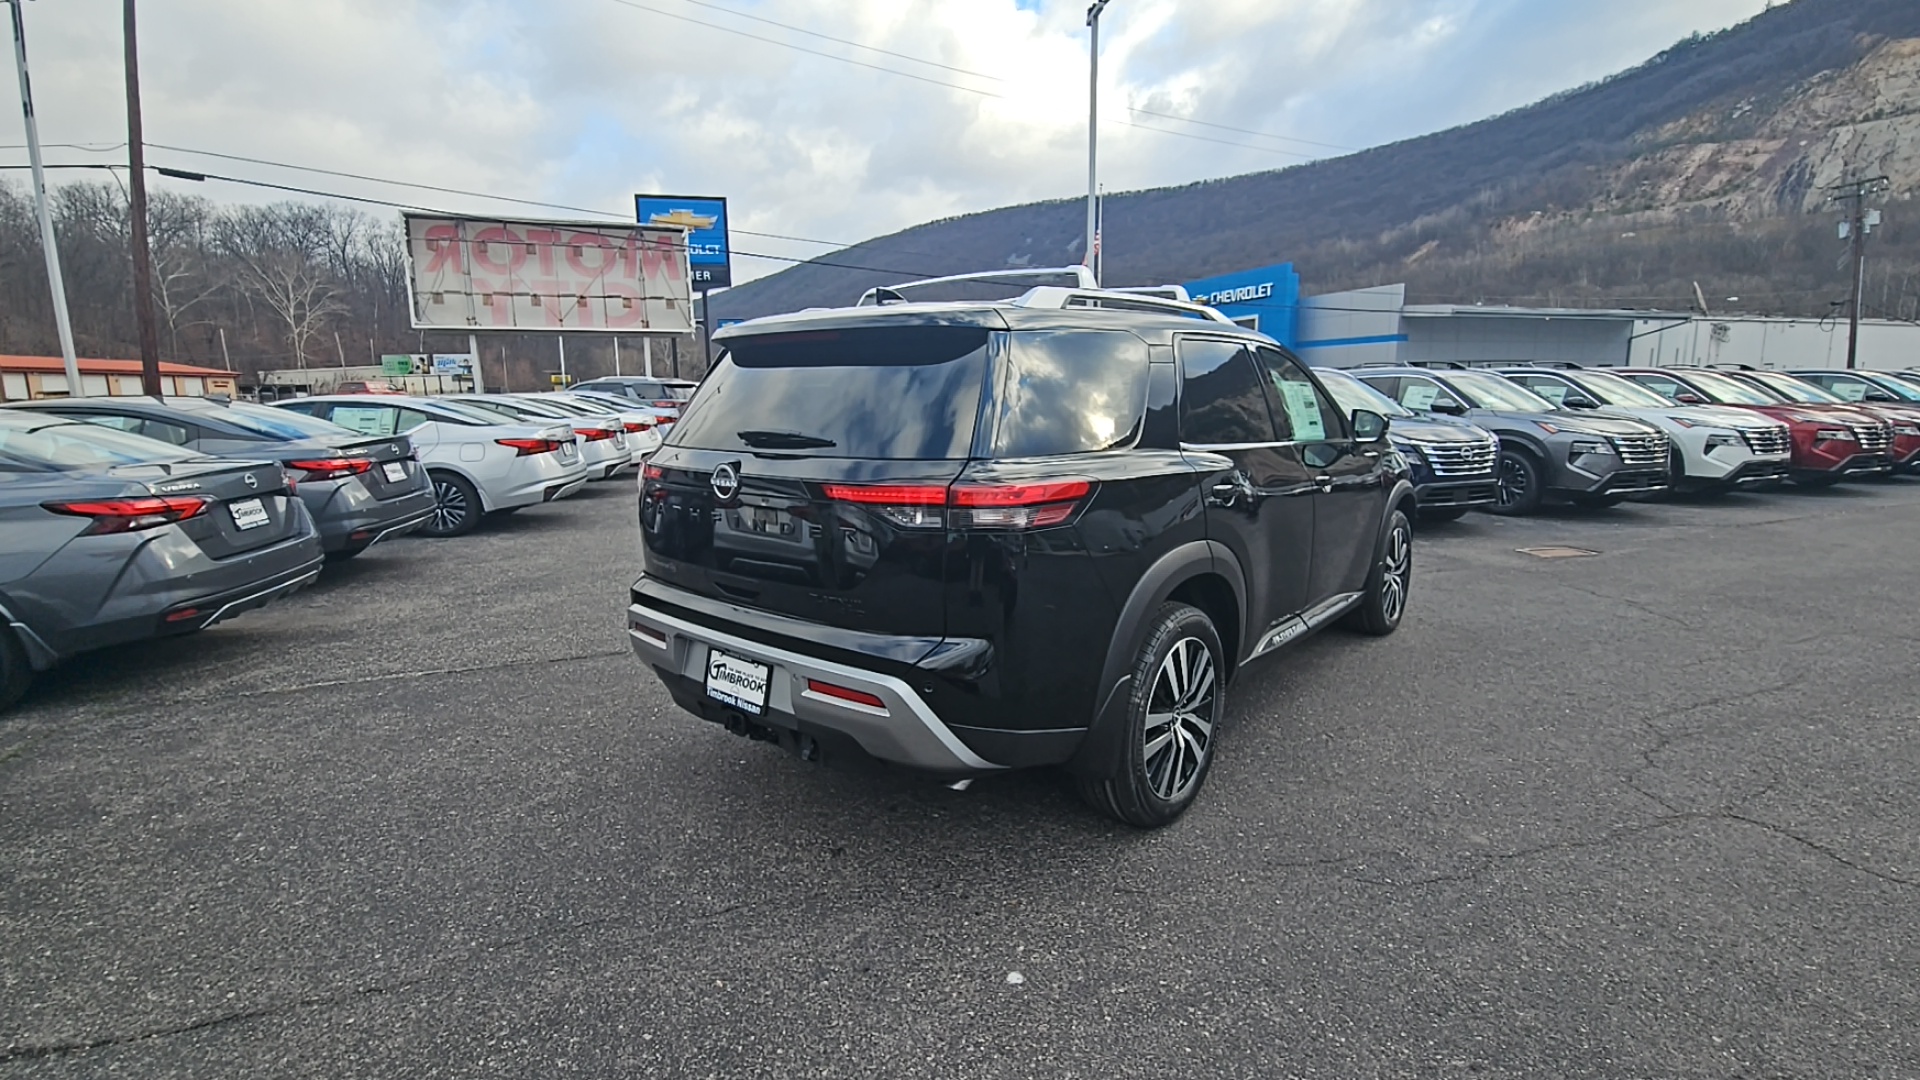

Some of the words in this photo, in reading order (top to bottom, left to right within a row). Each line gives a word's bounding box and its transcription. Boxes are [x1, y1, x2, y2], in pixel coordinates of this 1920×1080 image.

[689, 243, 721, 255] OLET
[1210, 282, 1274, 305] CHEVROLET
[710, 477, 738, 488] NISSAN
[709, 660, 766, 694] TIMBROOK
[707, 688, 736, 705] Timbrook
[737, 698, 761, 715] Nissan
